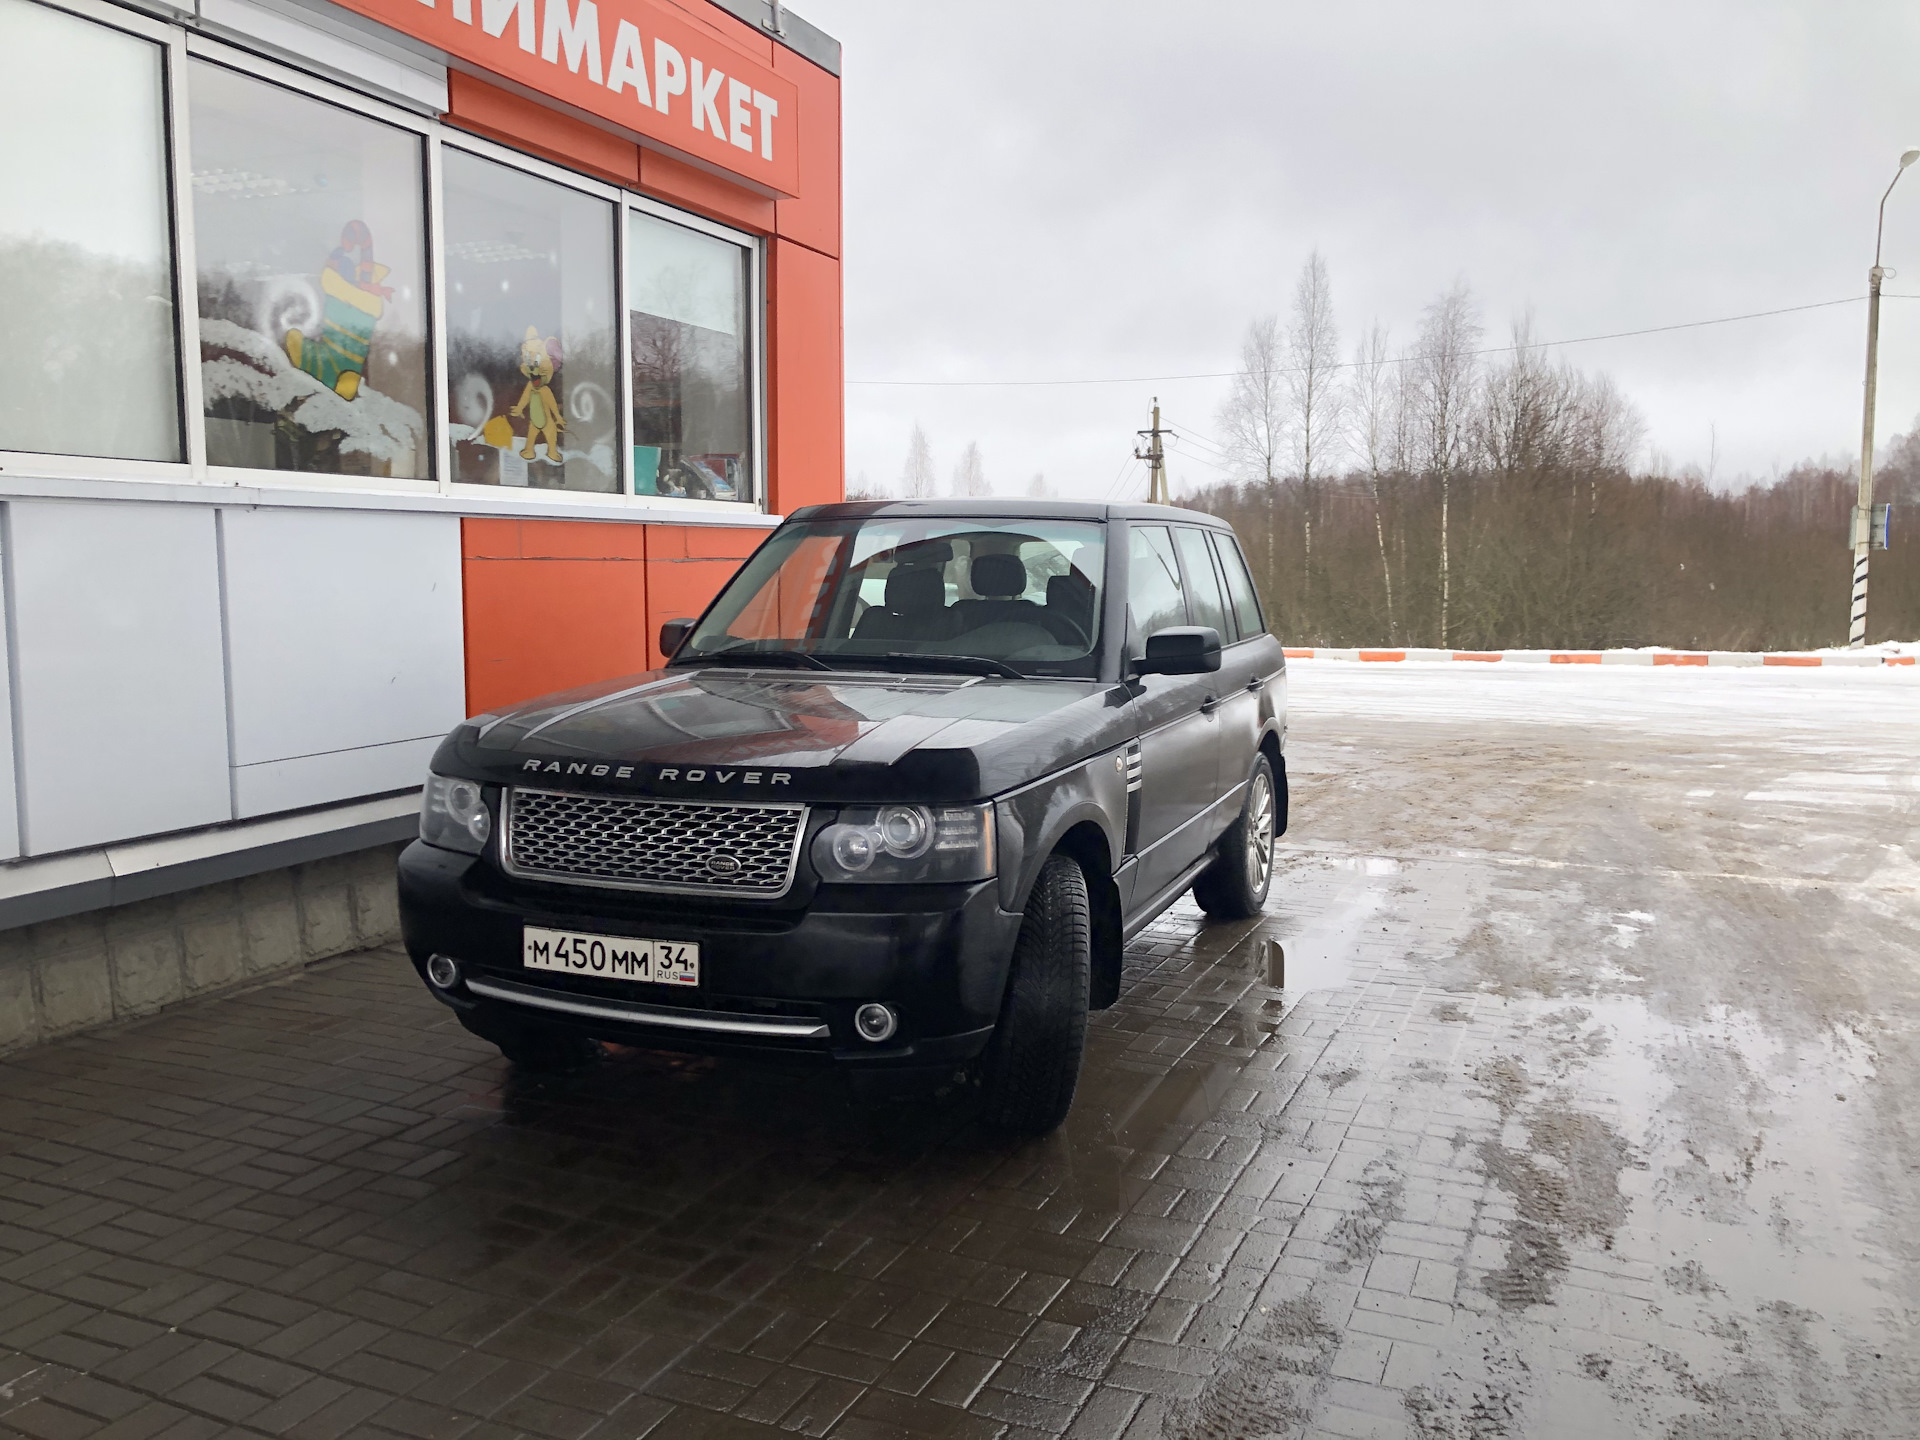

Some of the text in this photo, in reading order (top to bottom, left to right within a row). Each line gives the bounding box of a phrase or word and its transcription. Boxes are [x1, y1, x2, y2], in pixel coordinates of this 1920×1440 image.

[417, 0, 779, 161] ИМАРКЕТ
[523, 759, 792, 785] RANGE ROVER
[659, 945, 688, 972] 34
[657, 970, 679, 980] RUS
